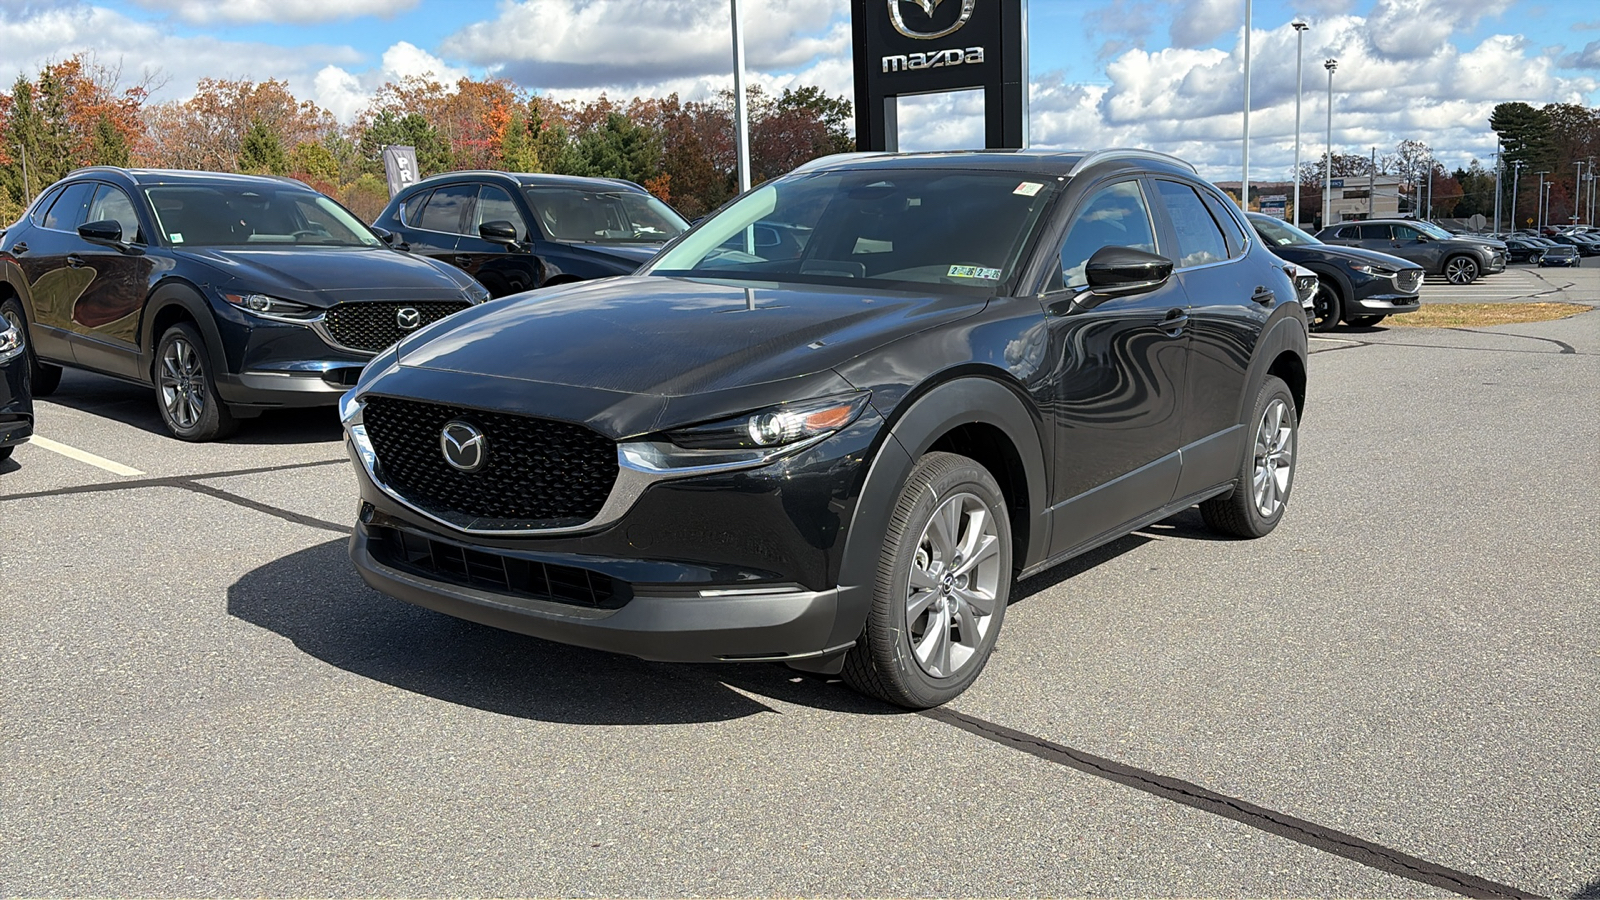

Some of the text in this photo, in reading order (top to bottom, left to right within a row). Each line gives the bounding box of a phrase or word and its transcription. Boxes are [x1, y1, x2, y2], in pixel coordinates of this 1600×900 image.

[882, 46, 984, 73] mazda
[951, 266, 958, 275] 2
[977, 268, 984, 277] 2
